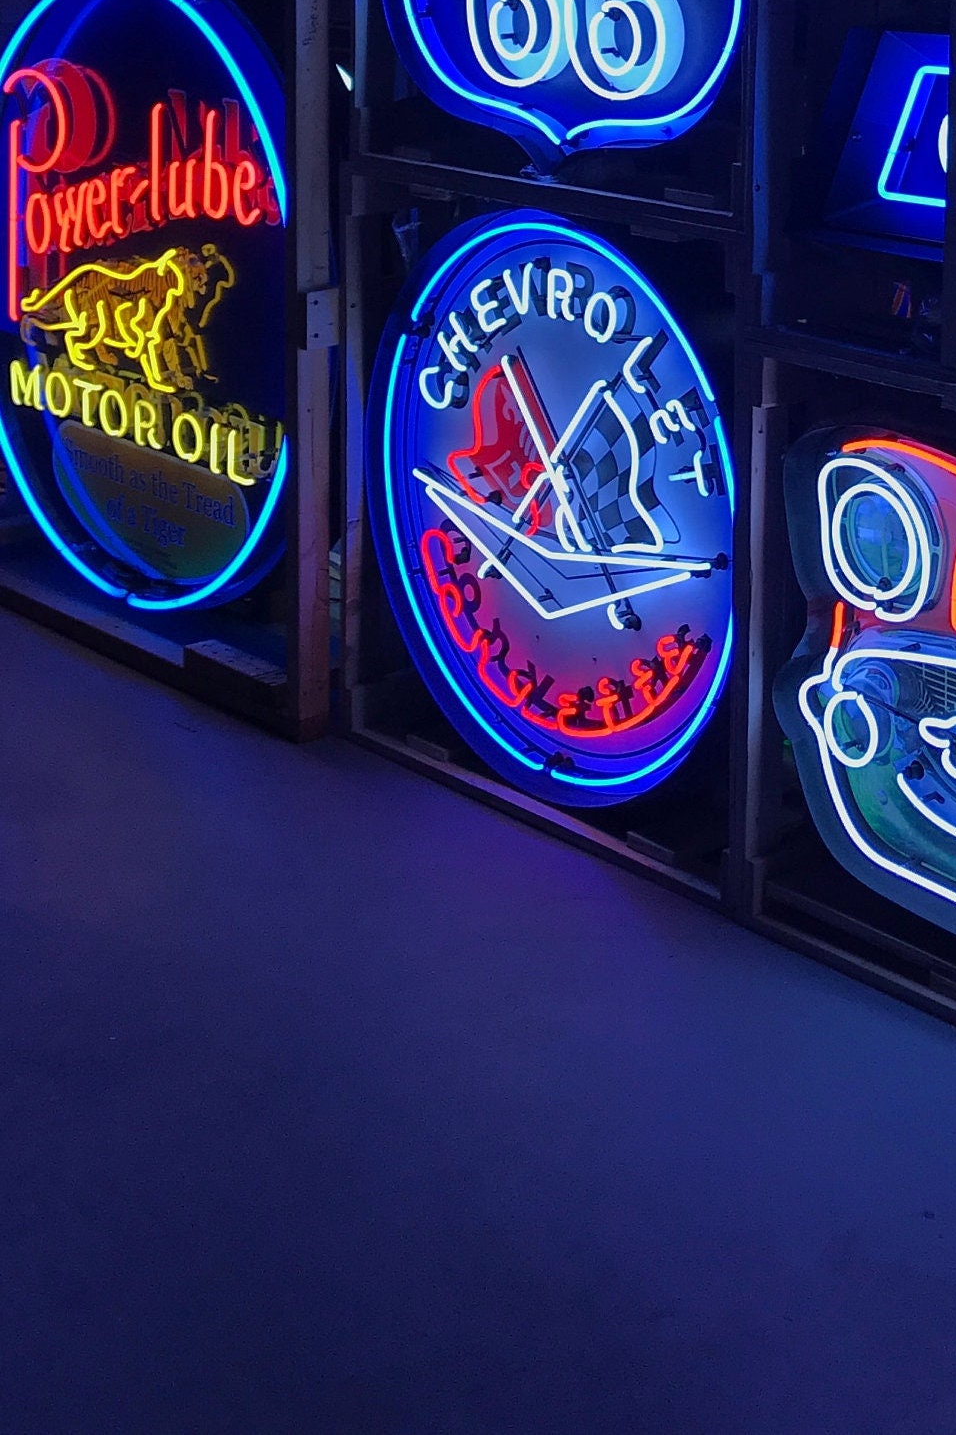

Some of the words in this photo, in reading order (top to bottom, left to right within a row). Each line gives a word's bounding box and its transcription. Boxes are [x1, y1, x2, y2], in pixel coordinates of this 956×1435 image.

[10, 359, 163, 450] MOTOR
[172, 412, 256, 486] OIL
[419, 260, 710, 497] CHEVROLET
[129, 468, 146, 492] as
[151, 470, 178, 506] the
[182, 480, 237, 528] Tread
[140, 504, 188, 547] Tiger
